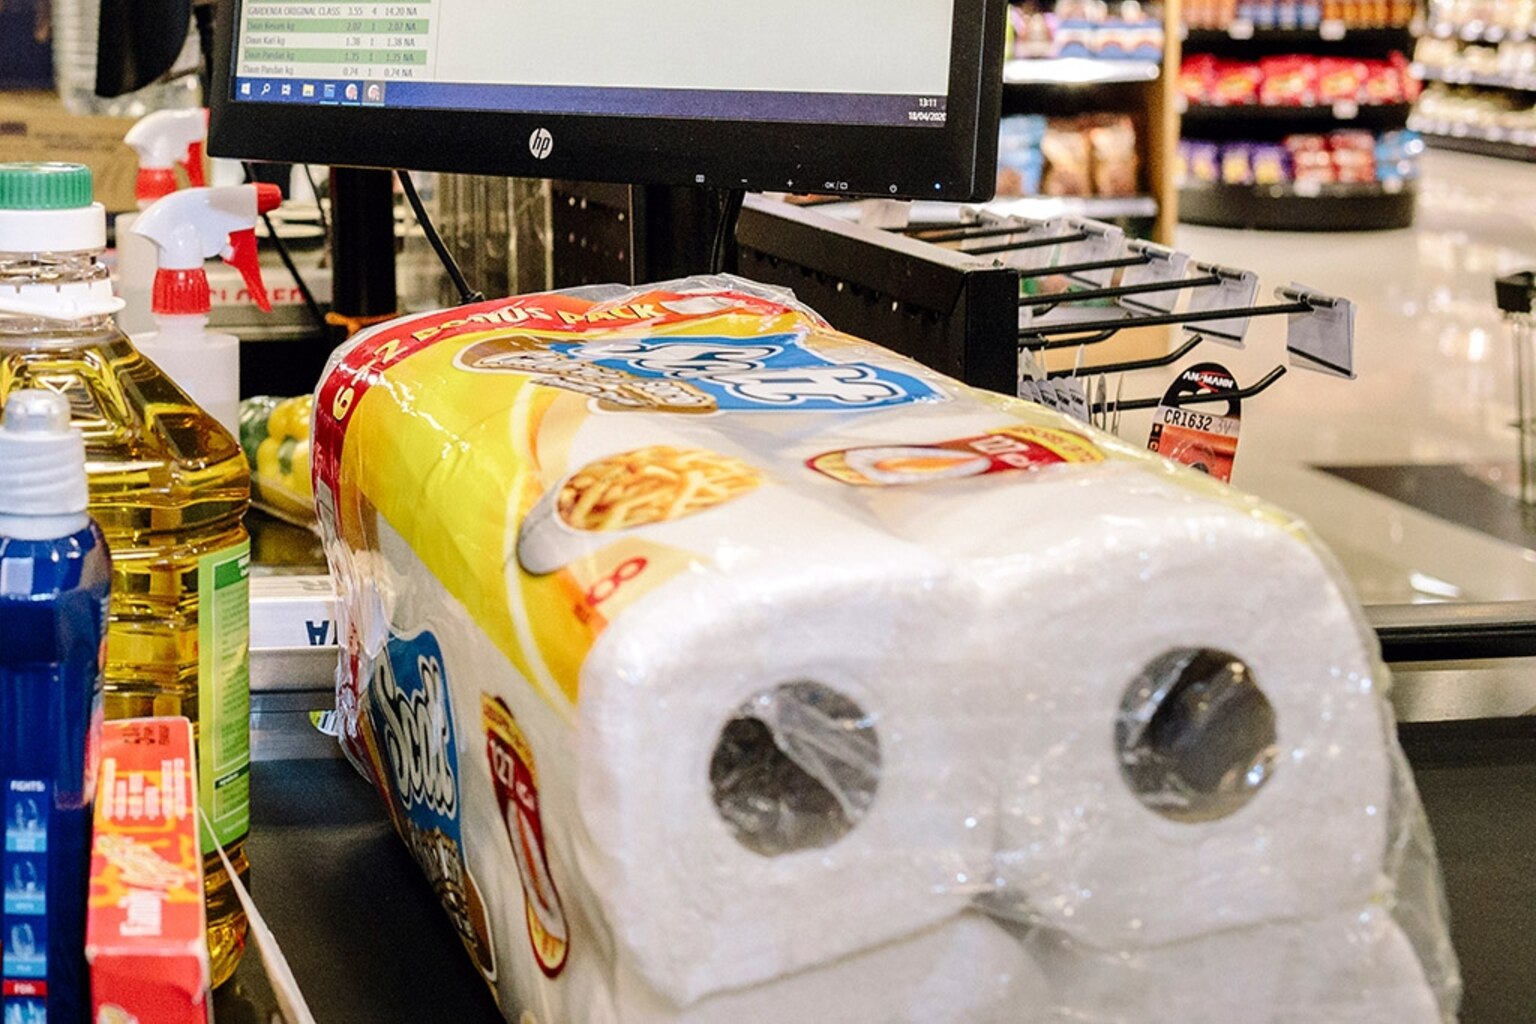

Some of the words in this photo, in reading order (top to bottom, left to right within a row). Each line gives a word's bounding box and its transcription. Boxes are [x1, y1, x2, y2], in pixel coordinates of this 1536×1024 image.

[406, 6, 417, 15] NA
[403, 37, 415, 45] NA
[401, 68, 413, 76] NA
[529, 127, 553, 160] hp
[557, 302, 659, 326] PACK
[1164, 409, 1213, 432] CR1632
[1215, 419, 1234, 434] 3V
